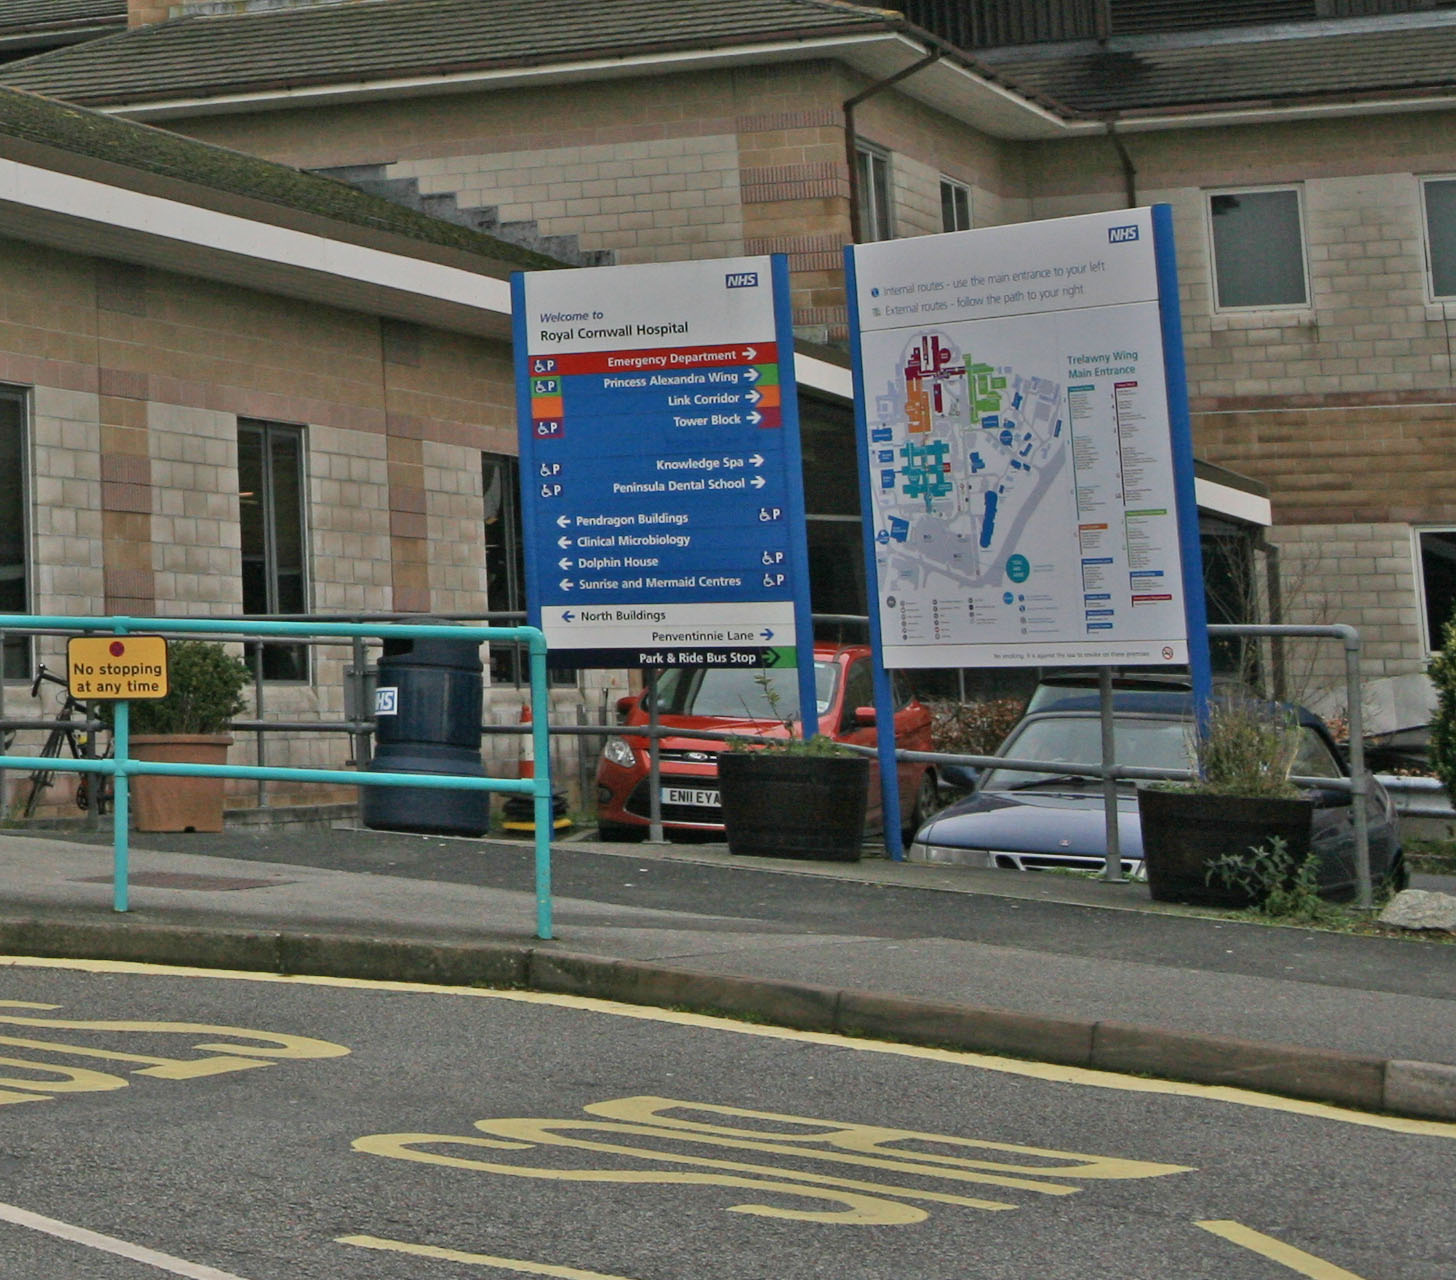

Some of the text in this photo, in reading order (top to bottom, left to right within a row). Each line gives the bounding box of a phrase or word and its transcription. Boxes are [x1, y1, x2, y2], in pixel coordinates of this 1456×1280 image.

[1109, 226, 1138, 242] NHS
[726, 273, 757, 288] NHS
[884, 283, 915, 296] Internal
[917, 280, 944, 292] routes
[953, 278, 968, 289] use
[970, 274, 985, 286] the
[988, 272, 1010, 284] main
[1012, 268, 1051, 282] entrance
[1053, 266, 1064, 278] to
[1066, 265, 1087, 279] your
[1089, 260, 1105, 273] left
[885, 303, 919, 316] External
[921, 300, 947, 313] routes
[957, 295, 984, 308] follow
[986, 293, 1001, 306] the
[1004, 291, 1024, 307] path
[1027, 289, 1037, 300] to
[1039, 286, 1060, 301] your
[1062, 283, 1084, 299] right
[540, 310, 603, 323] Welcome to
[540, 321, 688, 343] Royal Cornwall Hospital
[608, 350, 737, 368] Emergency Department
[1068, 350, 1138, 366] Trelawny Wing
[1069, 365, 1136, 379] Main Entrance
[604, 372, 738, 388] Princess Alexandra Wing
[668, 392, 740, 406] Link Corridor
[673, 413, 741, 427] Tower Block
[656, 456, 744, 471] Knowledge Spa
[613, 477, 745, 493] Peninsula Dental School
[576, 512, 689, 528] Pendragon Buildings
[577, 534, 691, 548] Clinical Microbiology
[578, 556, 659, 570] Dolphin House
[579, 575, 742, 590] Sunrise and Mermaid Centres
[581, 609, 666, 622] North Buildings
[652, 630, 754, 642] Penventinnie Lane
[639, 651, 756, 665] Park & Ride Bus Stop
[74, 662, 162, 677] No stopping
[77, 680, 159, 694] at any time
[376, 691, 394, 711] HS
[669, 789, 721, 804] EN11 EYA
[351, 1095, 1196, 1225] BUS
